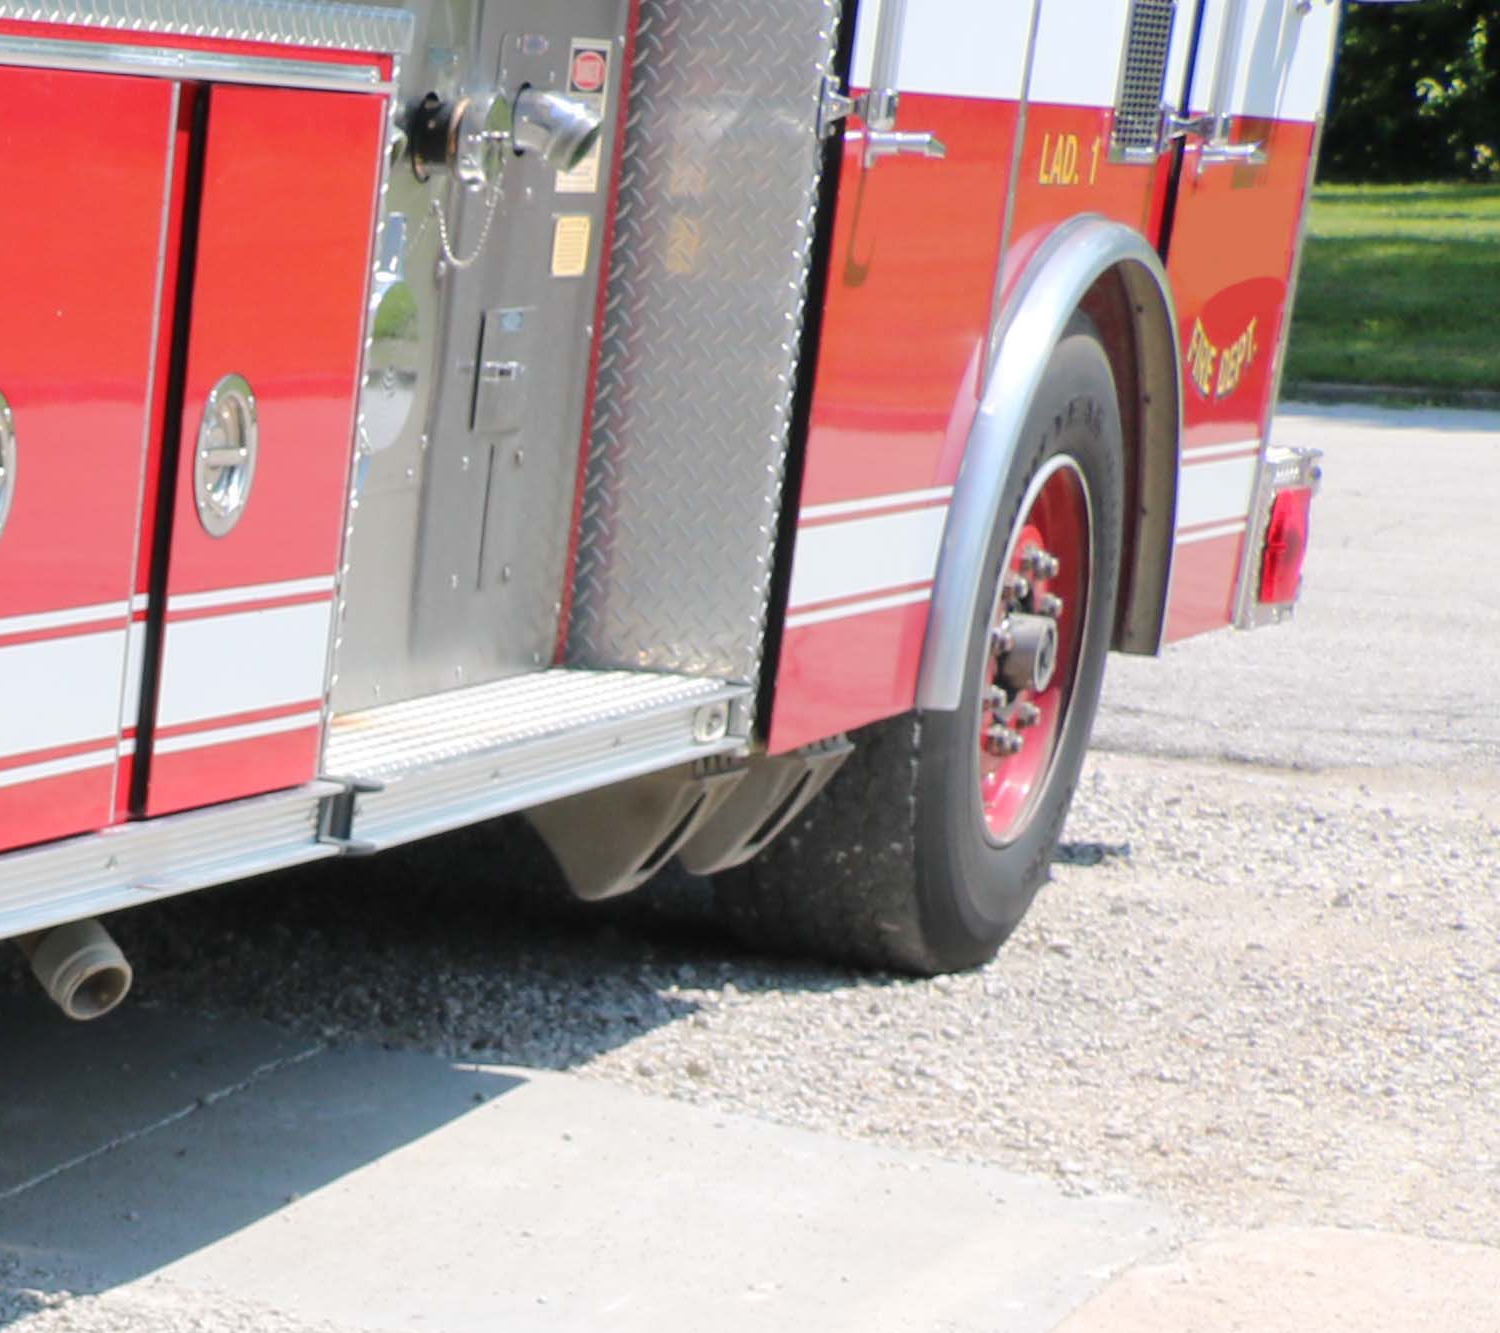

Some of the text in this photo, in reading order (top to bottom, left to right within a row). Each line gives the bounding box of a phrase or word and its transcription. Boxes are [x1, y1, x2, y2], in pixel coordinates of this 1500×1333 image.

[1039, 132, 1102, 185] LAD. 1
[1186, 314, 1259, 399] FIRE DEPT.
